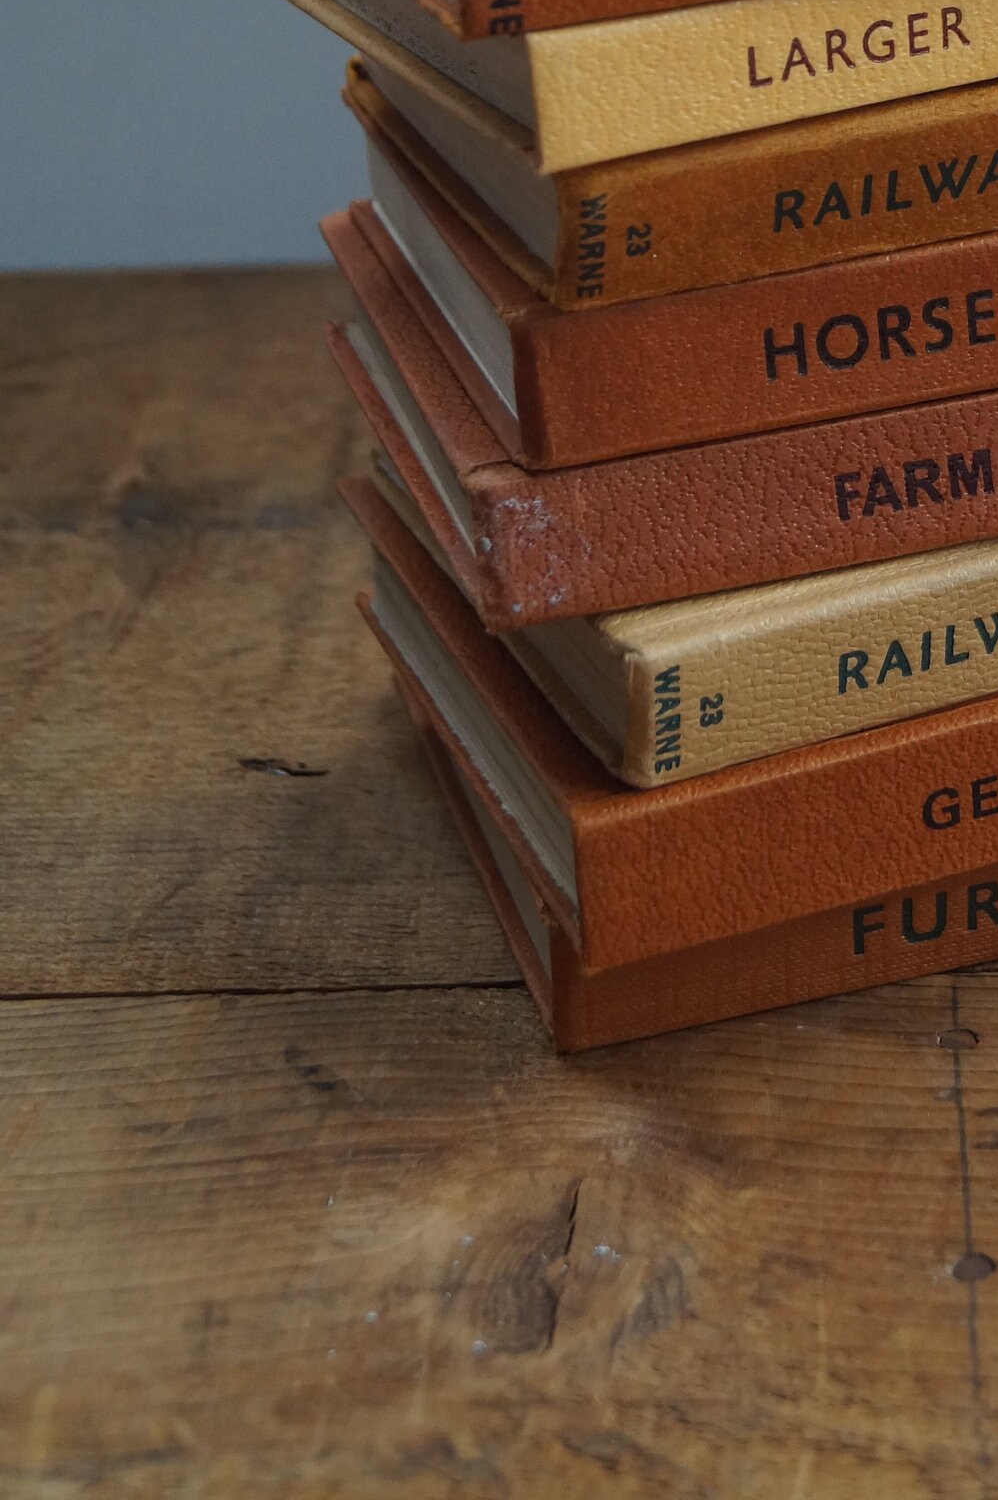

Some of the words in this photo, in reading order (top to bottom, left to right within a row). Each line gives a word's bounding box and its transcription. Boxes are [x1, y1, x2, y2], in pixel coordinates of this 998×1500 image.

[746, 7, 971, 89] LARGER
[576, 192, 608, 299] WARNE
[625, 223, 653, 258] 23
[834, 449, 996, 522] FARM
[654, 664, 682, 775] WARNE
[699, 692, 724, 728] 23
